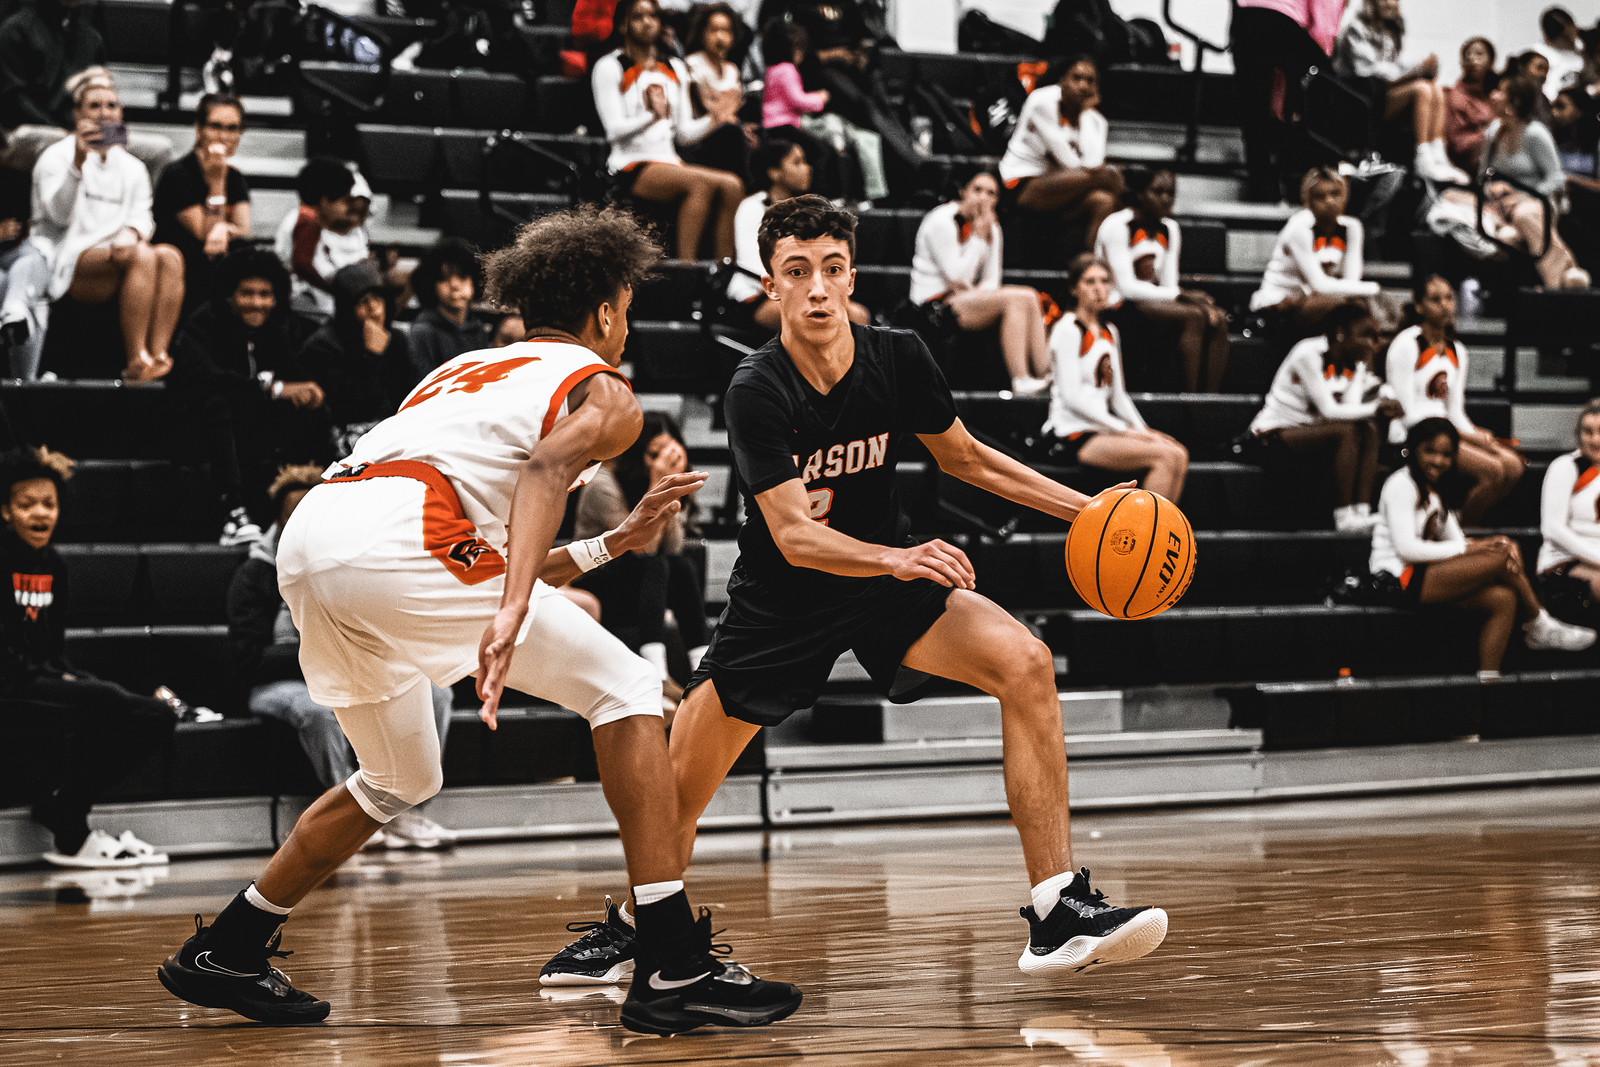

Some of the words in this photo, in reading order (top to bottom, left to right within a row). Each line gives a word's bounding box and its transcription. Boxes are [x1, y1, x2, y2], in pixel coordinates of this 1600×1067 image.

[396, 357, 542, 415] 24
[793, 432, 889, 484] RSON
[1159, 532, 1181, 584] EVO
